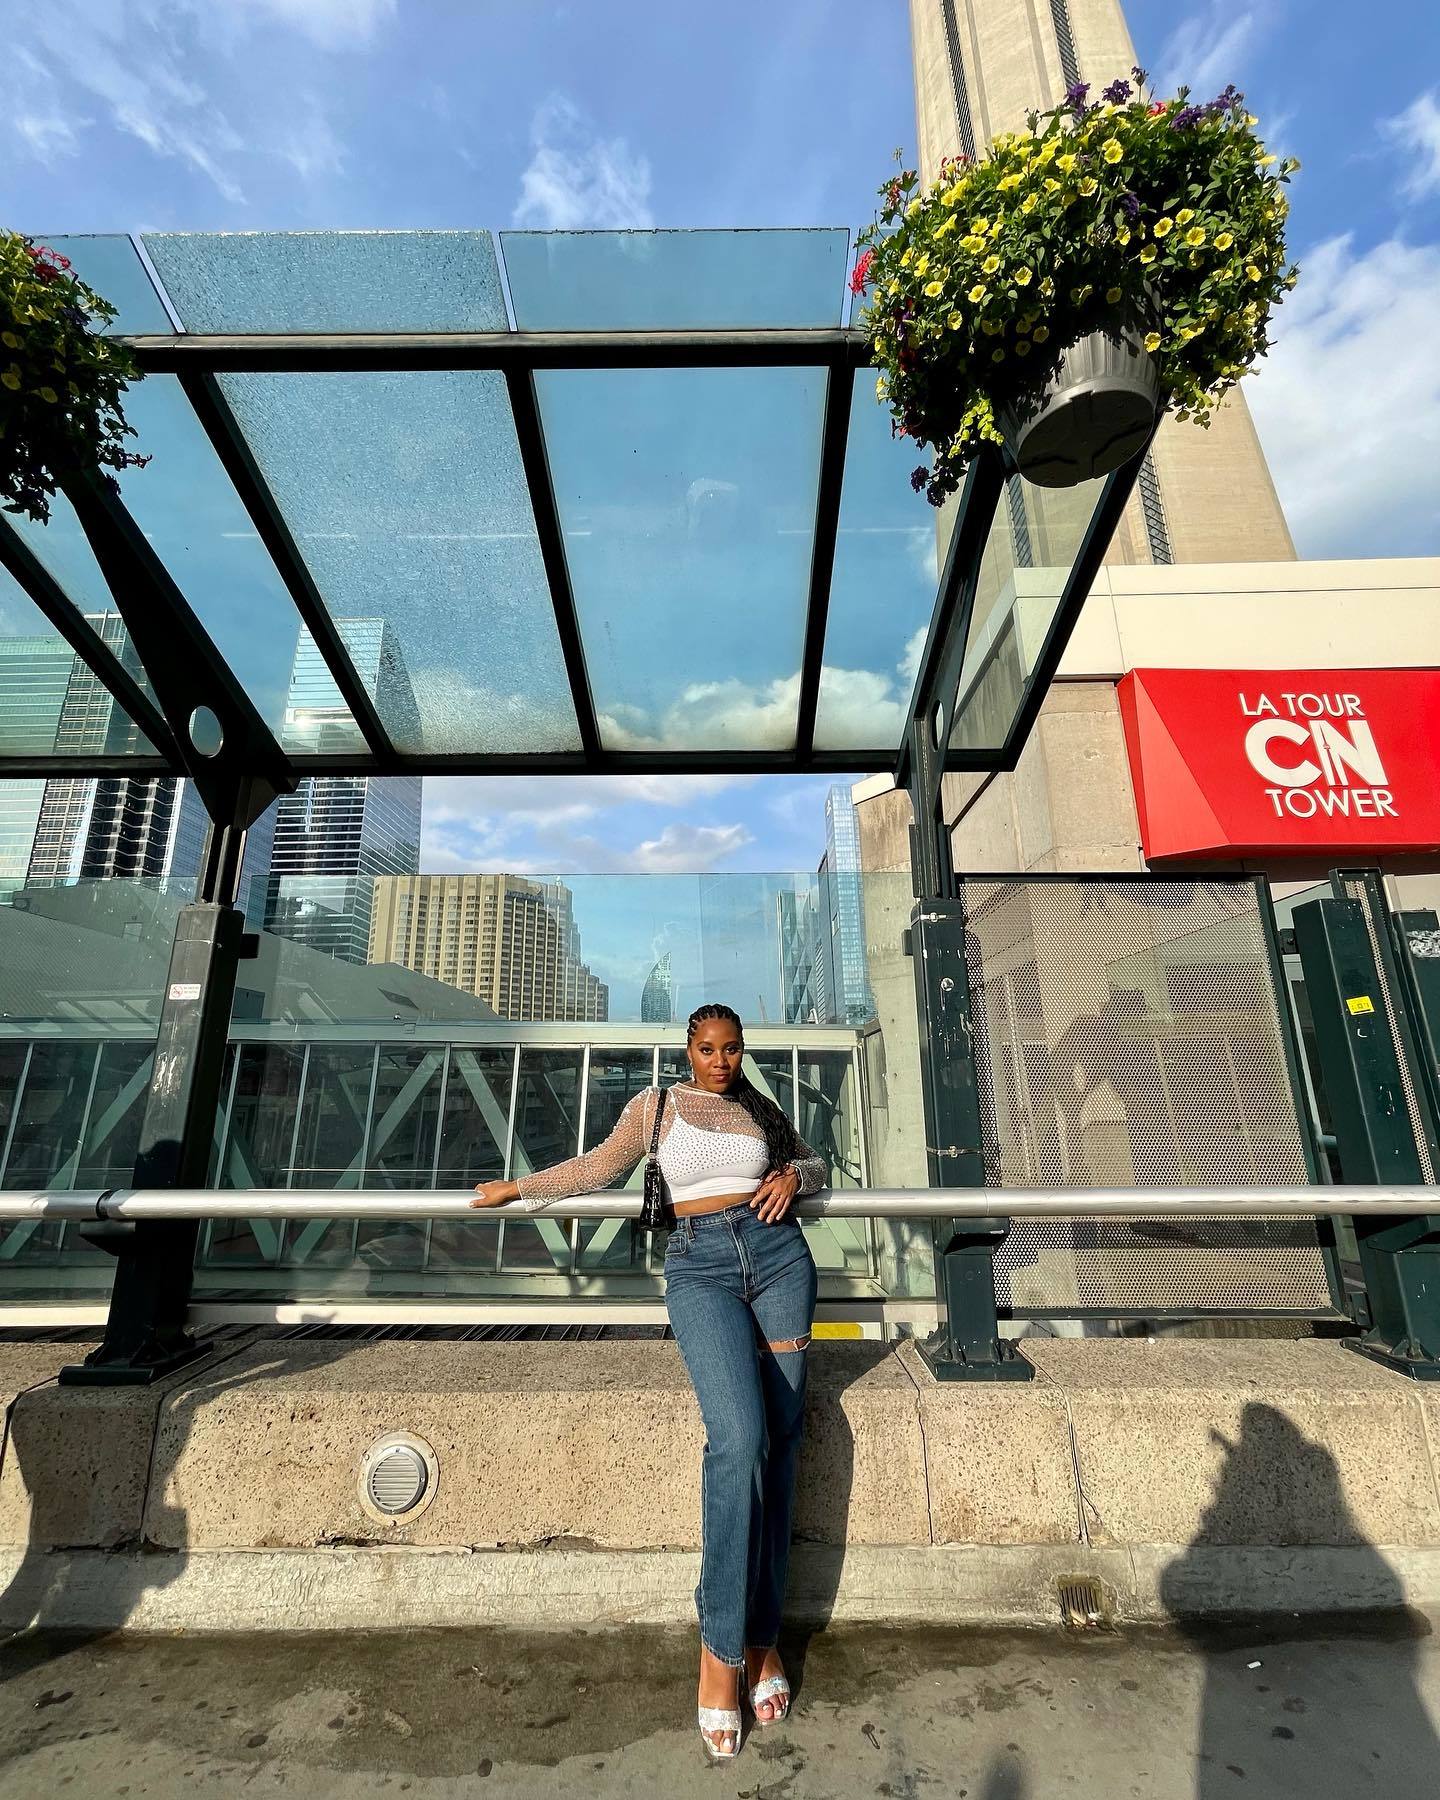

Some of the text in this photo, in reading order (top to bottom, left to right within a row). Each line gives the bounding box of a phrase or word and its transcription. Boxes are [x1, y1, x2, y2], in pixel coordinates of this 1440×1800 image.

[1239, 693, 1365, 717] LA TOUR
[1244, 718, 1389, 787] CN
[1265, 789, 1399, 818] TOWER
